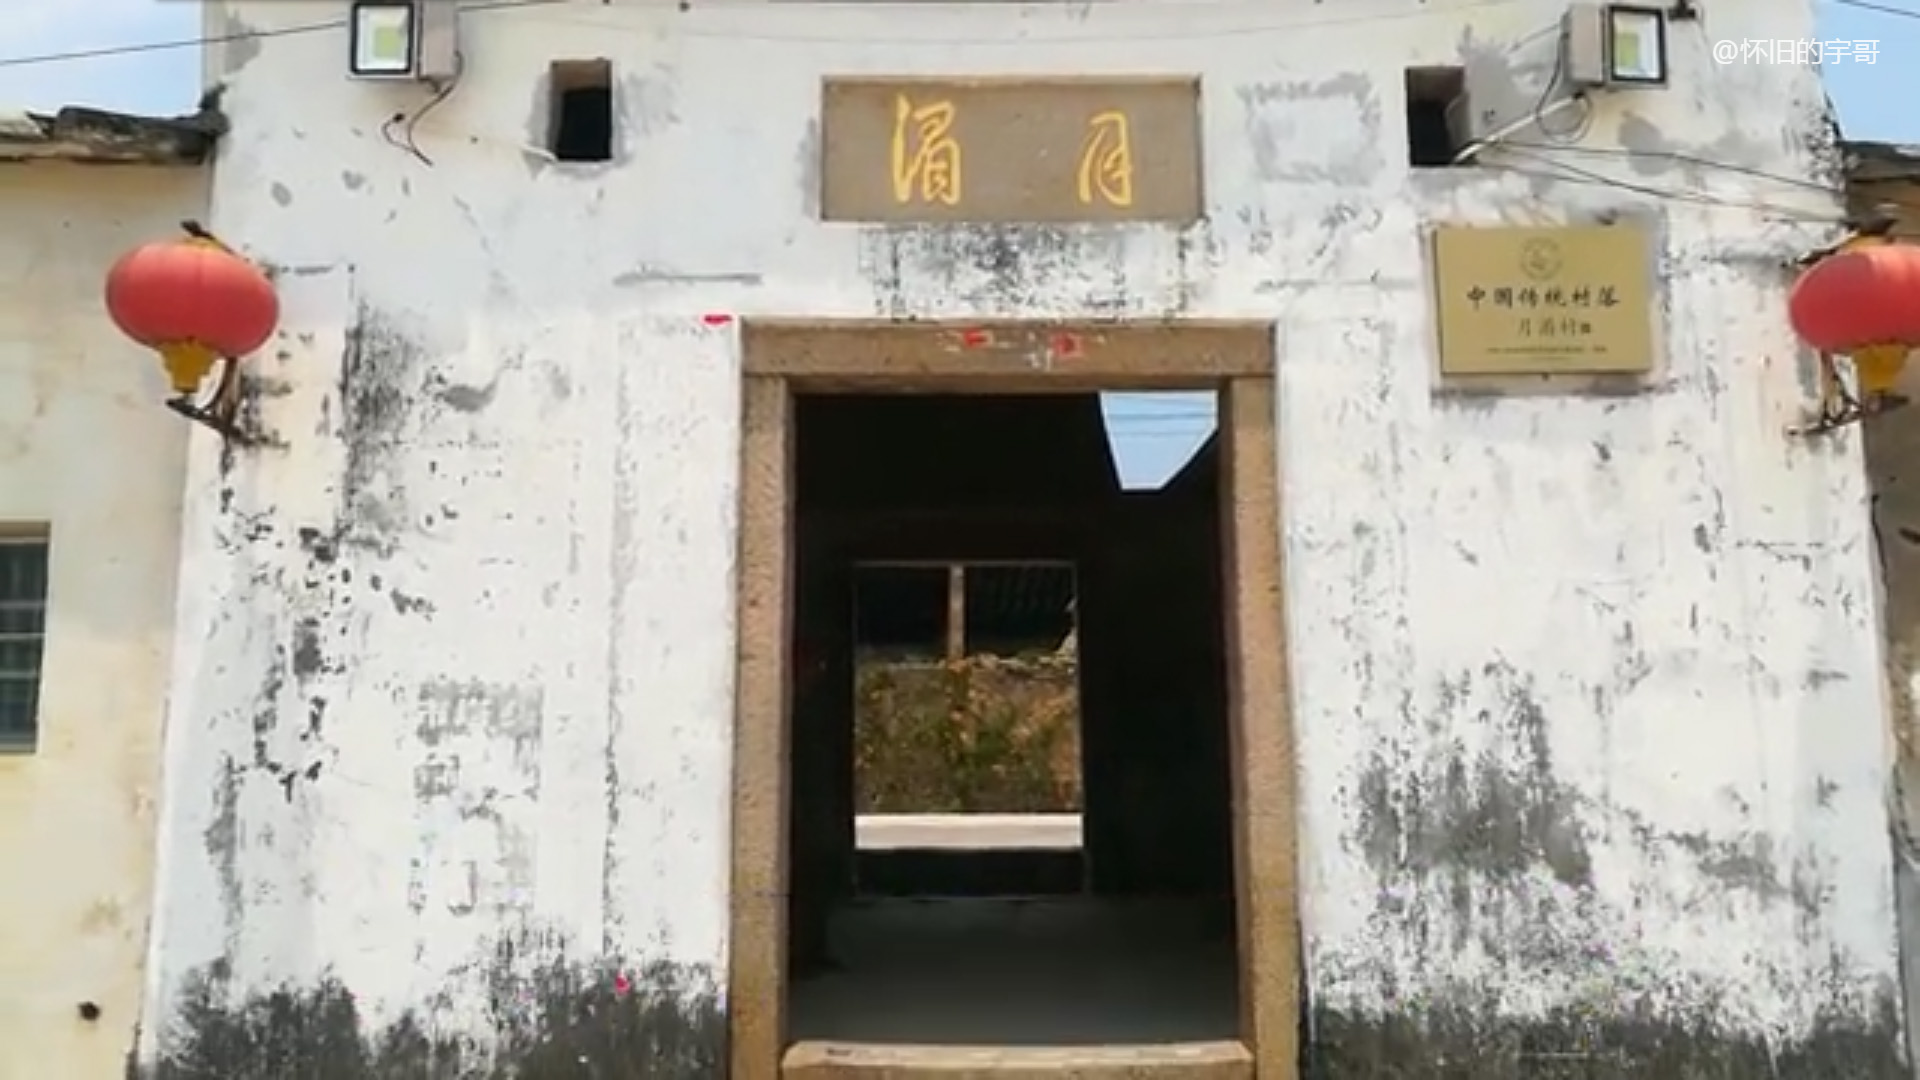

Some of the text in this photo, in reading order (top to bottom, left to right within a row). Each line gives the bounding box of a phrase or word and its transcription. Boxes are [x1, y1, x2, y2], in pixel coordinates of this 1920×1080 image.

[1466, 285, 1620, 311] 中国传统村落
